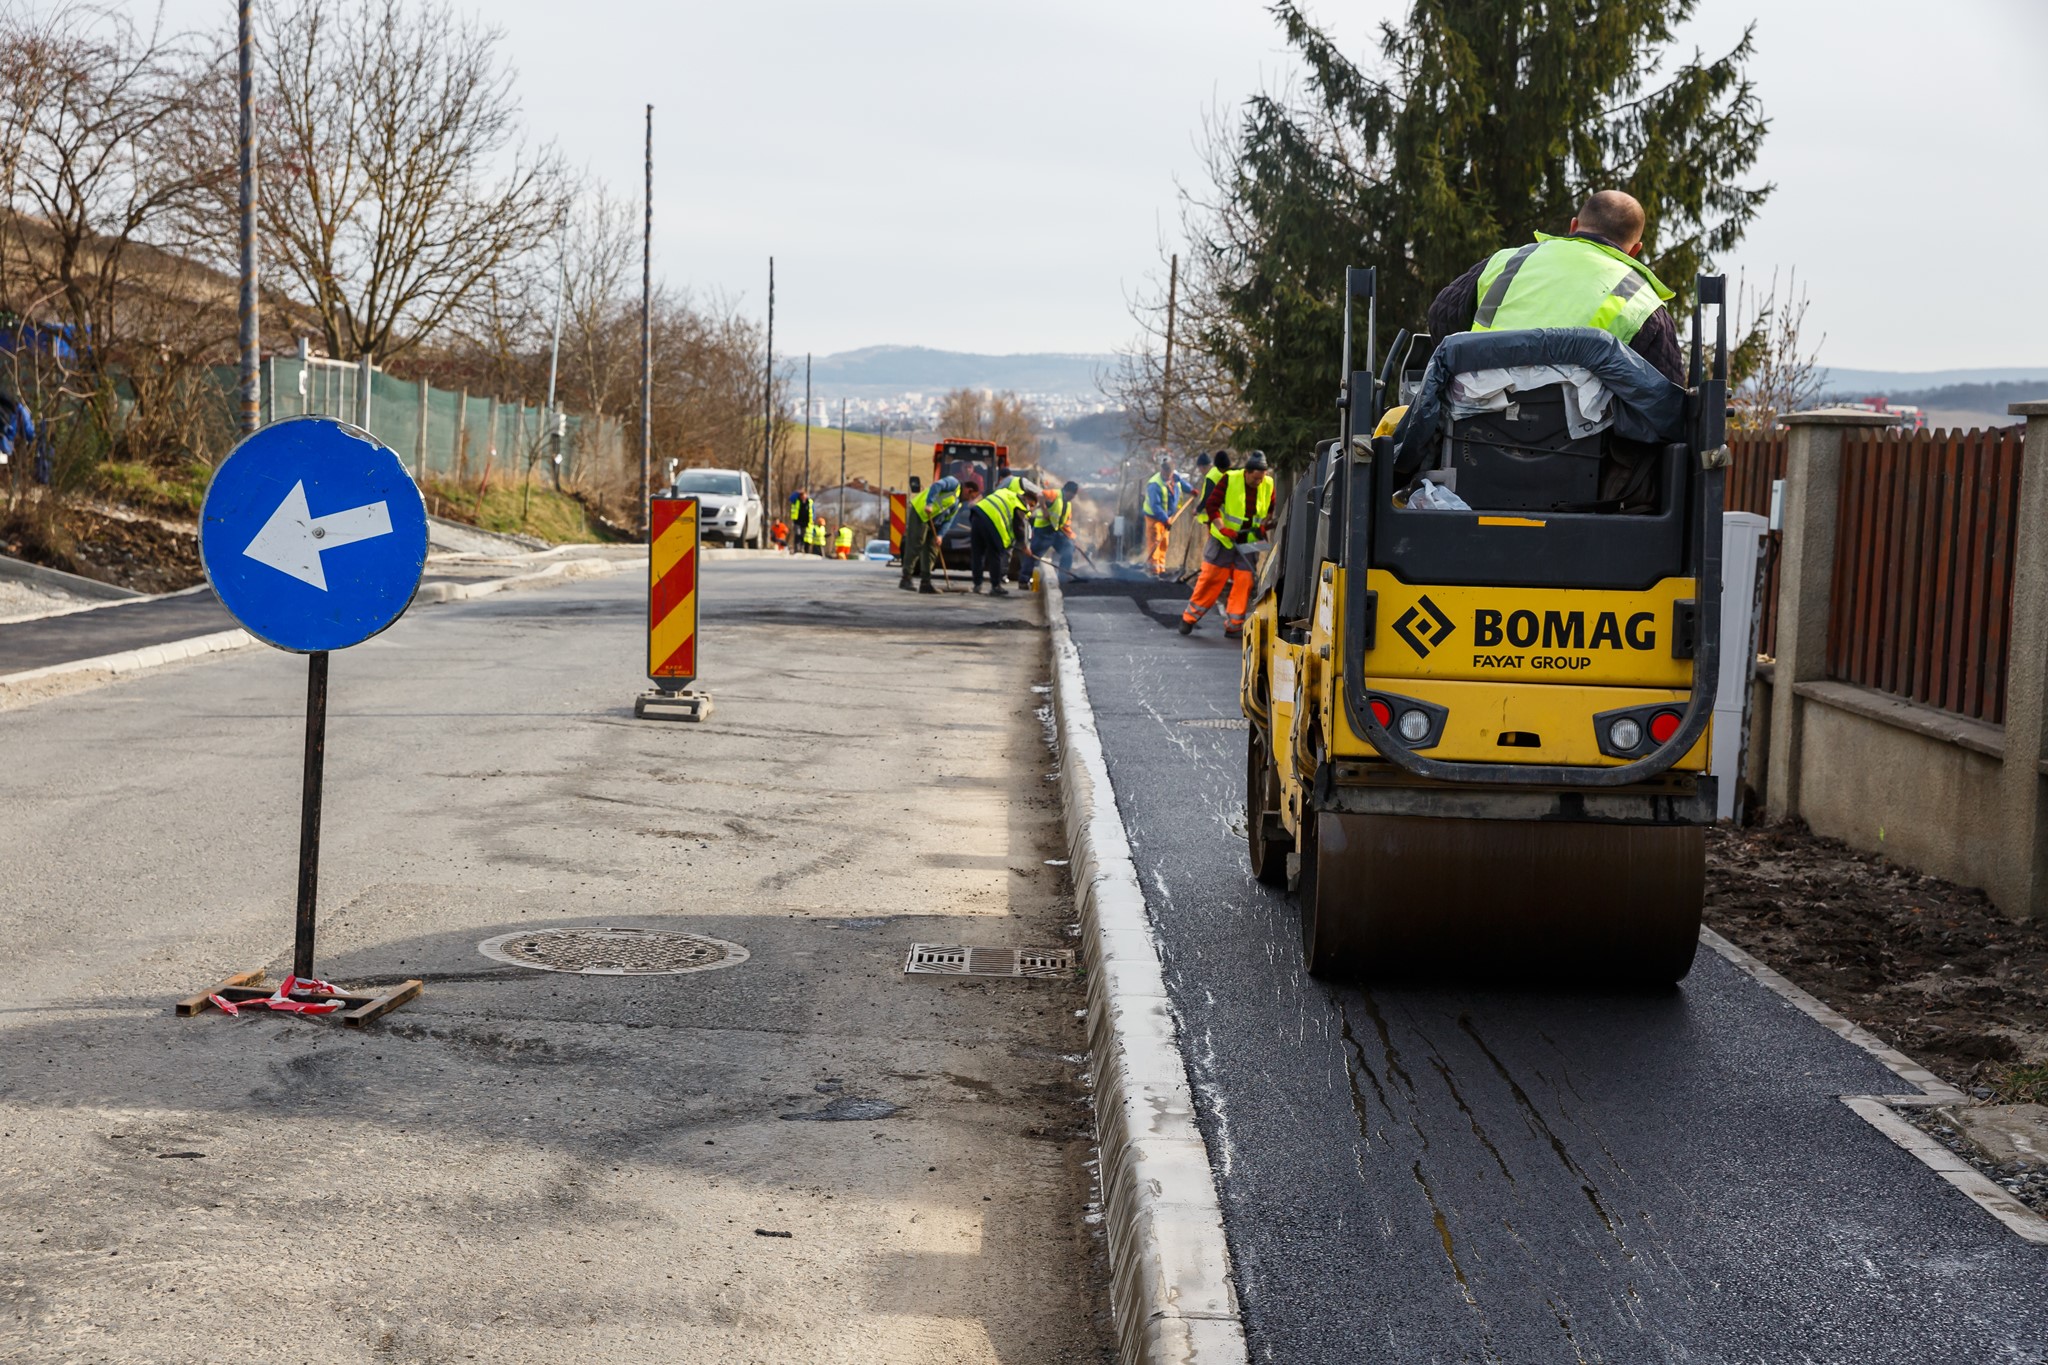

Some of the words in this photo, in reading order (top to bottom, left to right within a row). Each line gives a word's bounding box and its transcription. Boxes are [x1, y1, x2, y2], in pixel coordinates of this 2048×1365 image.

[1474, 609, 1656, 650] BOMAG
[1473, 655, 1525, 668] FAYAT
[1530, 656, 1591, 669] GROUP
